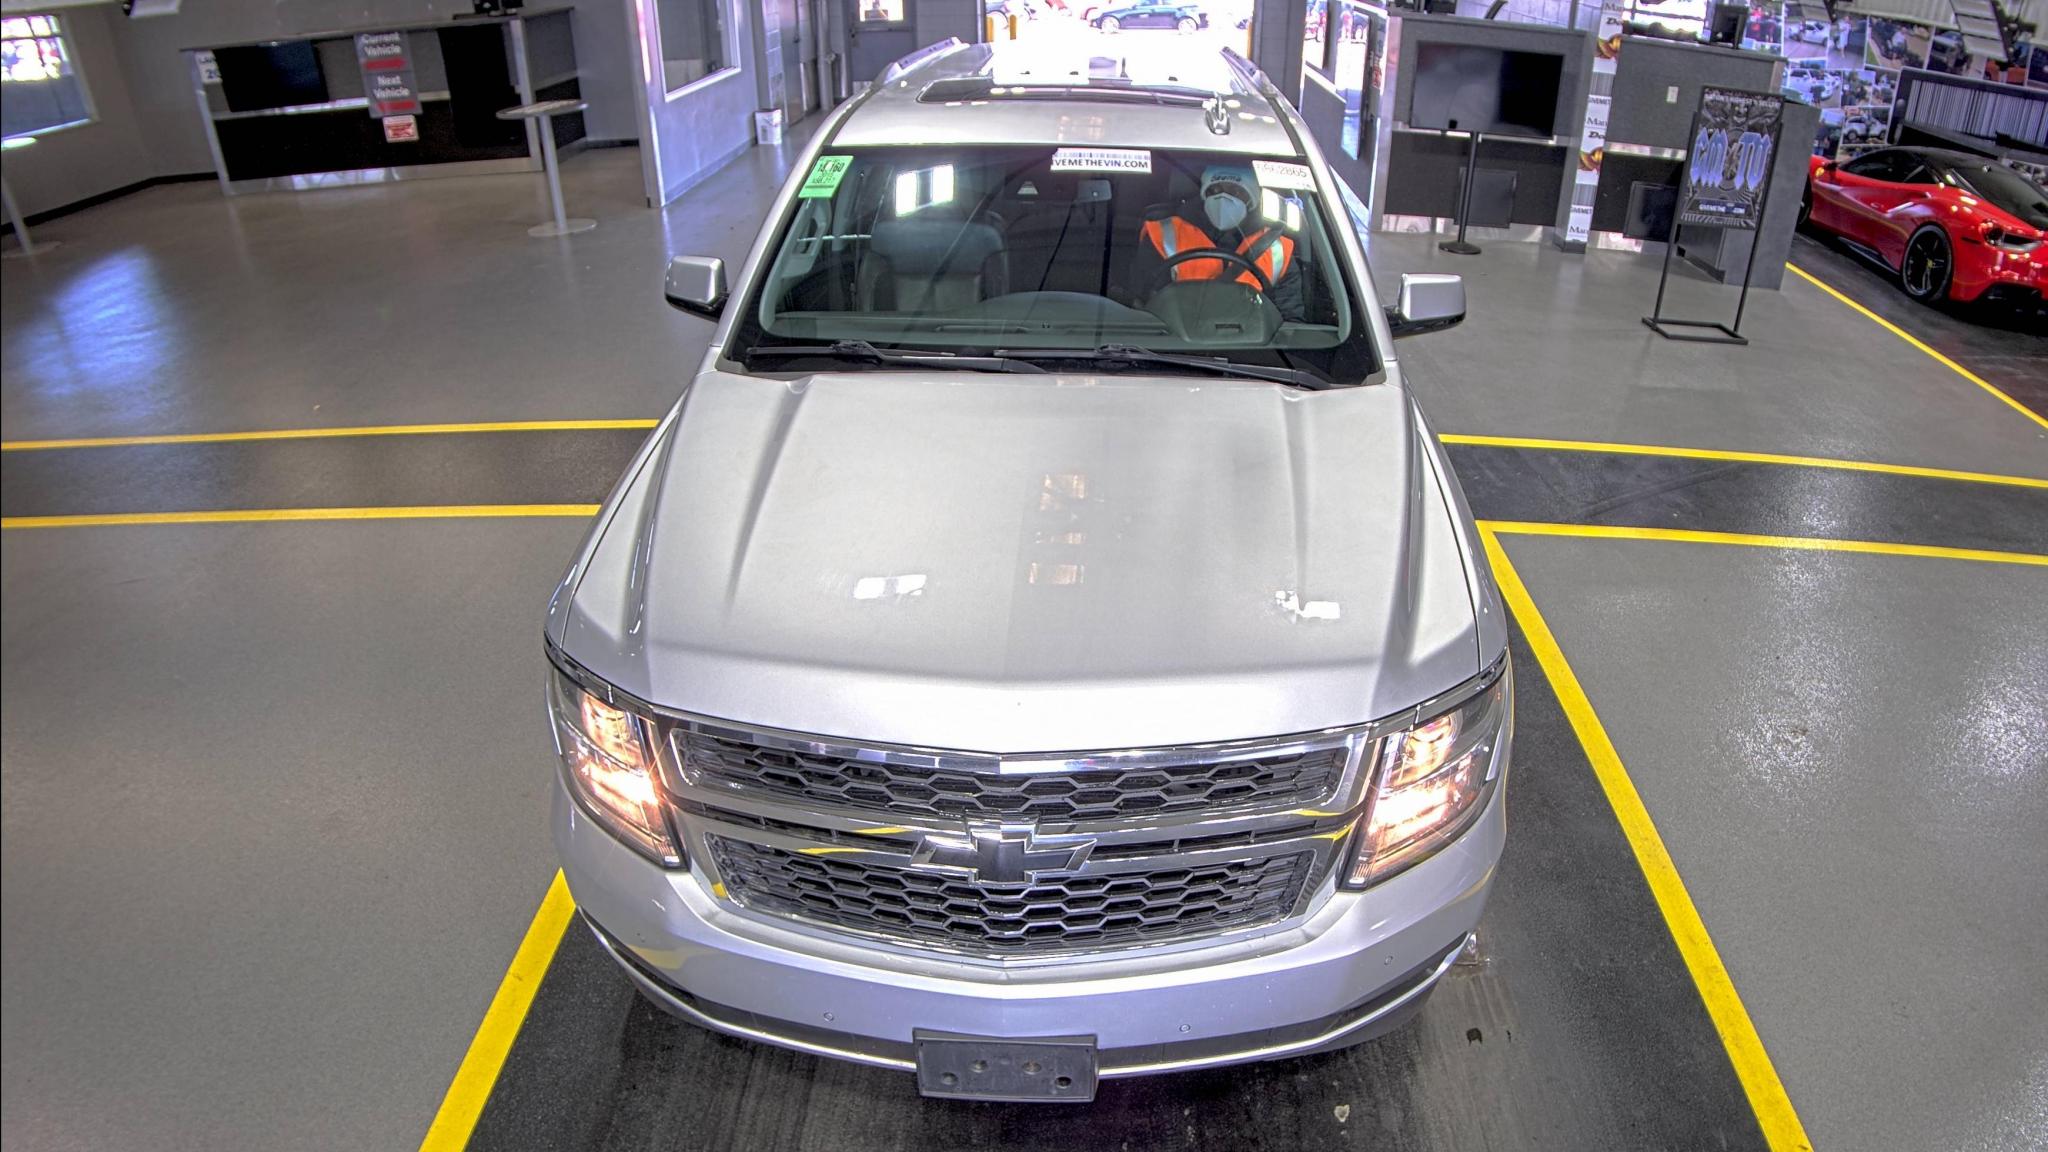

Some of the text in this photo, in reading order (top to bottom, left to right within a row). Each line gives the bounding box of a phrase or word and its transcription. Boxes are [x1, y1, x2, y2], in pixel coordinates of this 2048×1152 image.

[360, 31, 400, 44] Current
[364, 44, 402, 56] Vehicle
[377, 75, 402, 87] Next
[373, 87, 410, 99] Vehicle
